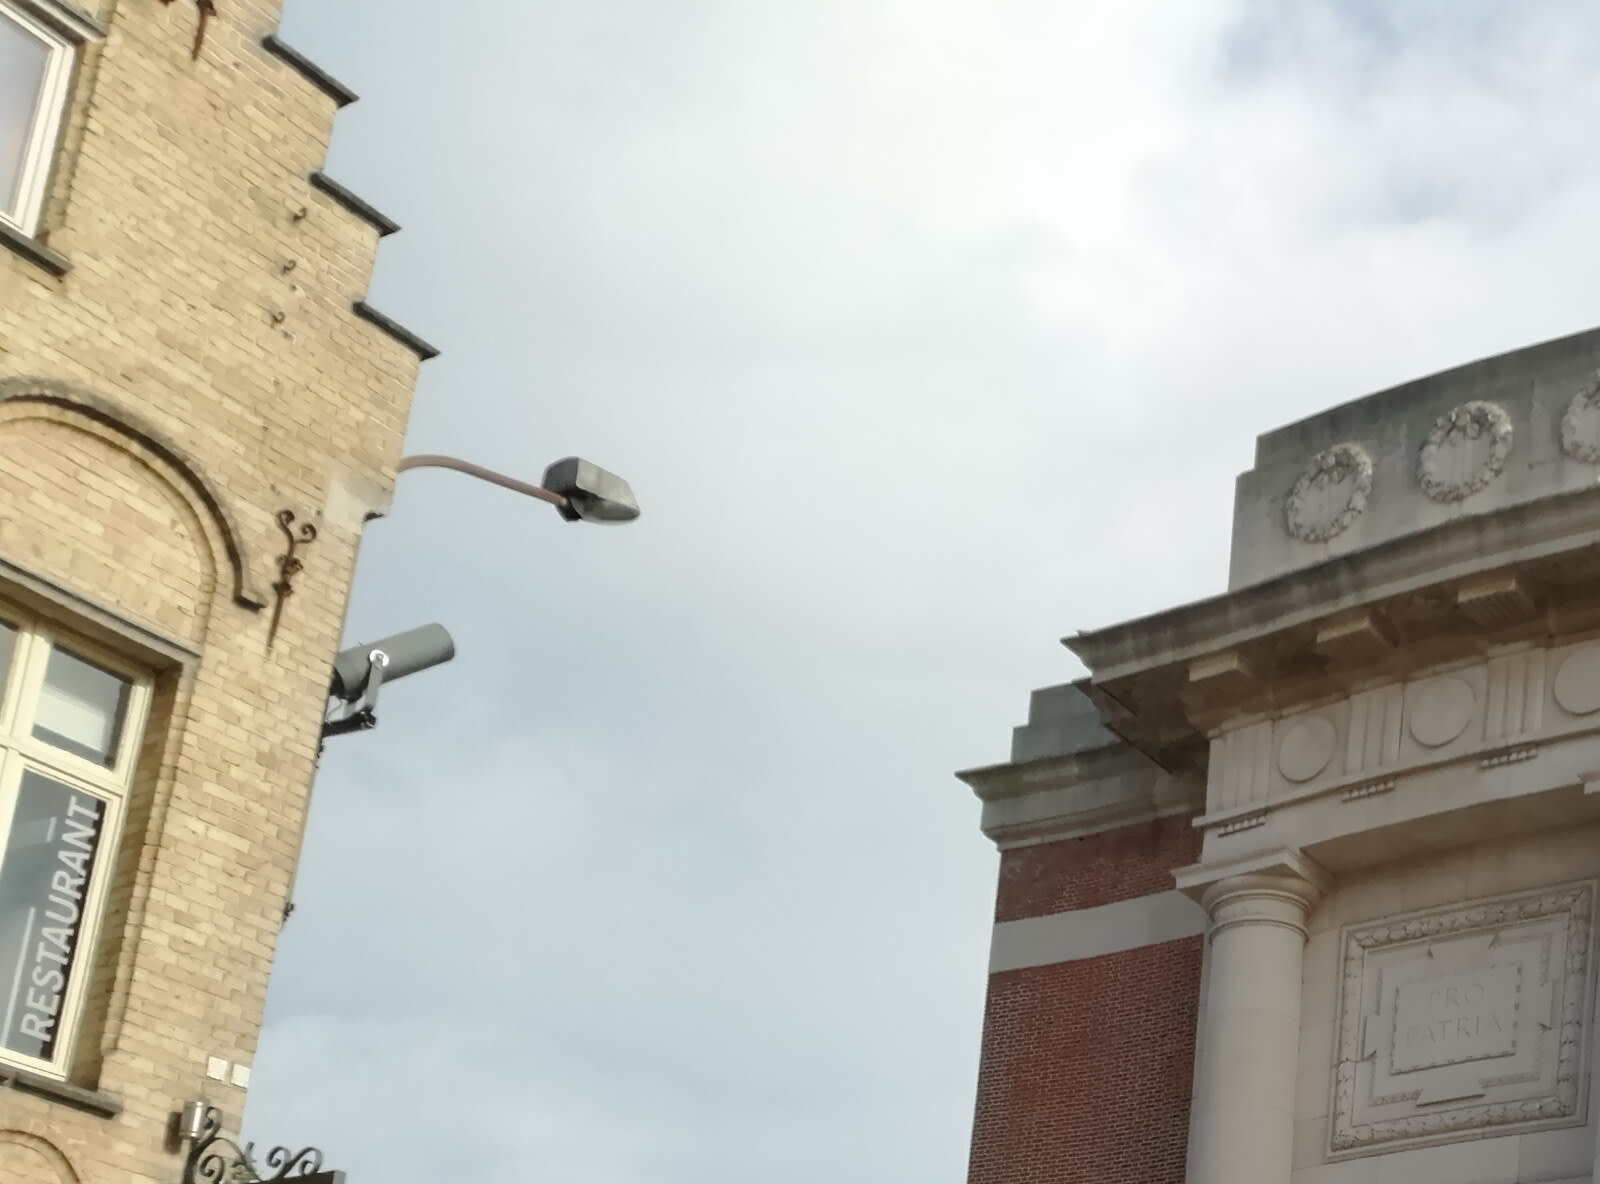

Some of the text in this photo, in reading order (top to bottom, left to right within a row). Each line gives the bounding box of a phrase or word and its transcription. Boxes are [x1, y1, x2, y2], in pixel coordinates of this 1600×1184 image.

[19, 794, 101, 1043] RESTAURANT
[1428, 981, 1486, 1011] PRO
[1404, 1013, 1504, 1048] PATRIA
